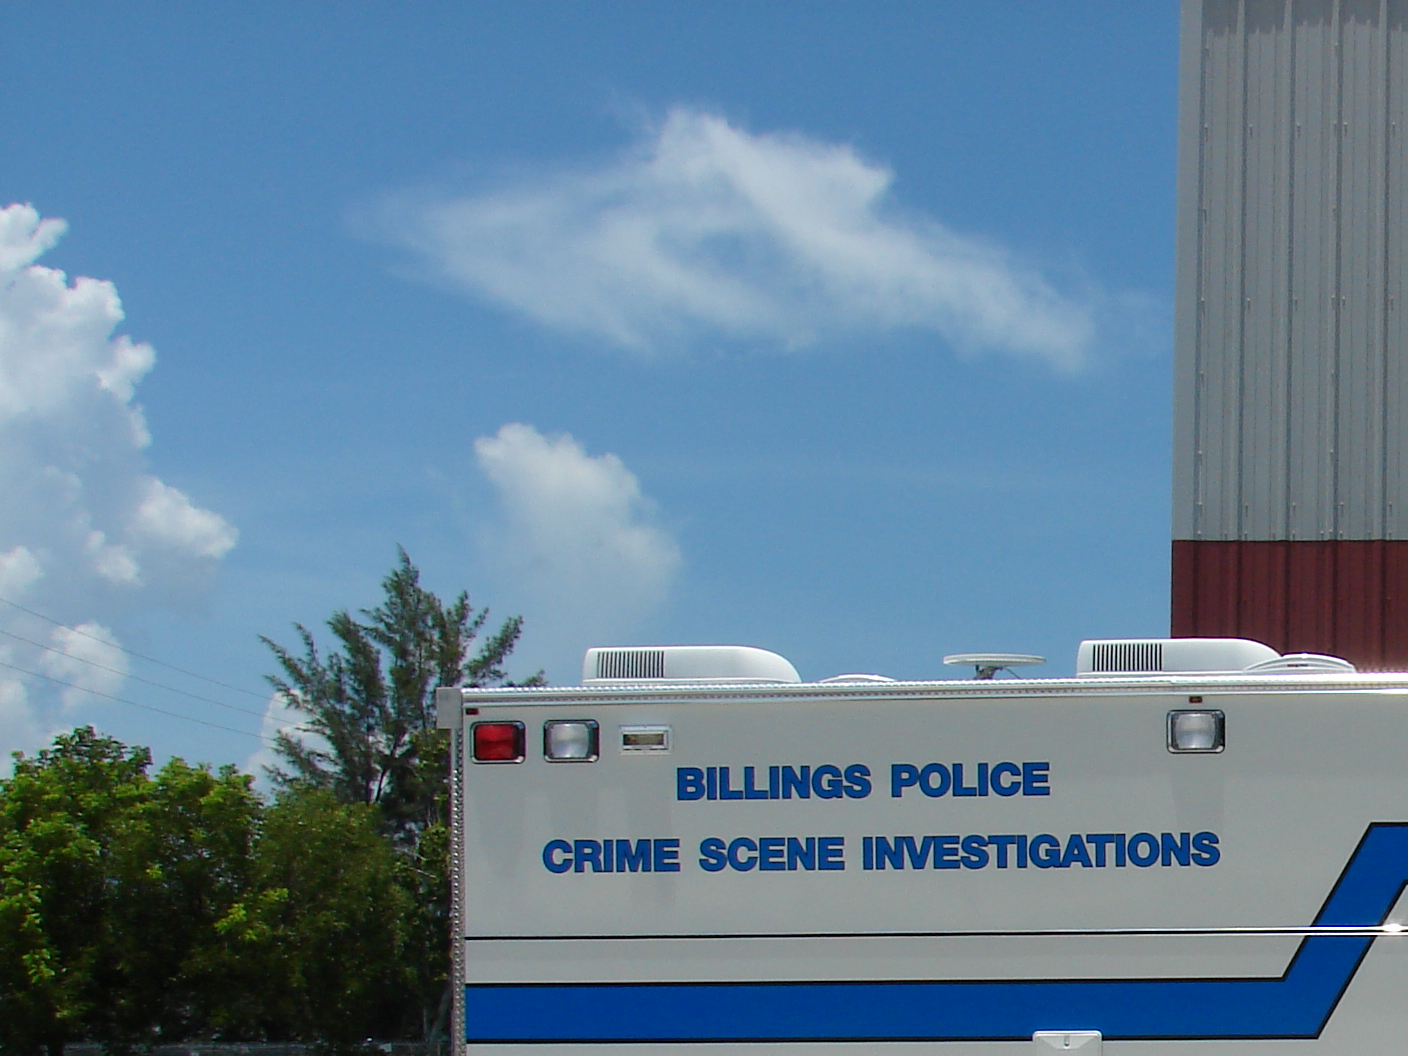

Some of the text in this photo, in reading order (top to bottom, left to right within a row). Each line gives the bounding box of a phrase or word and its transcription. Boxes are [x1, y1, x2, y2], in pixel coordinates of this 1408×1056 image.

[676, 761, 1051, 801] BILLINGS POLICE
[541, 831, 1221, 874] CRIME SCENE INVESTIGATIONS
